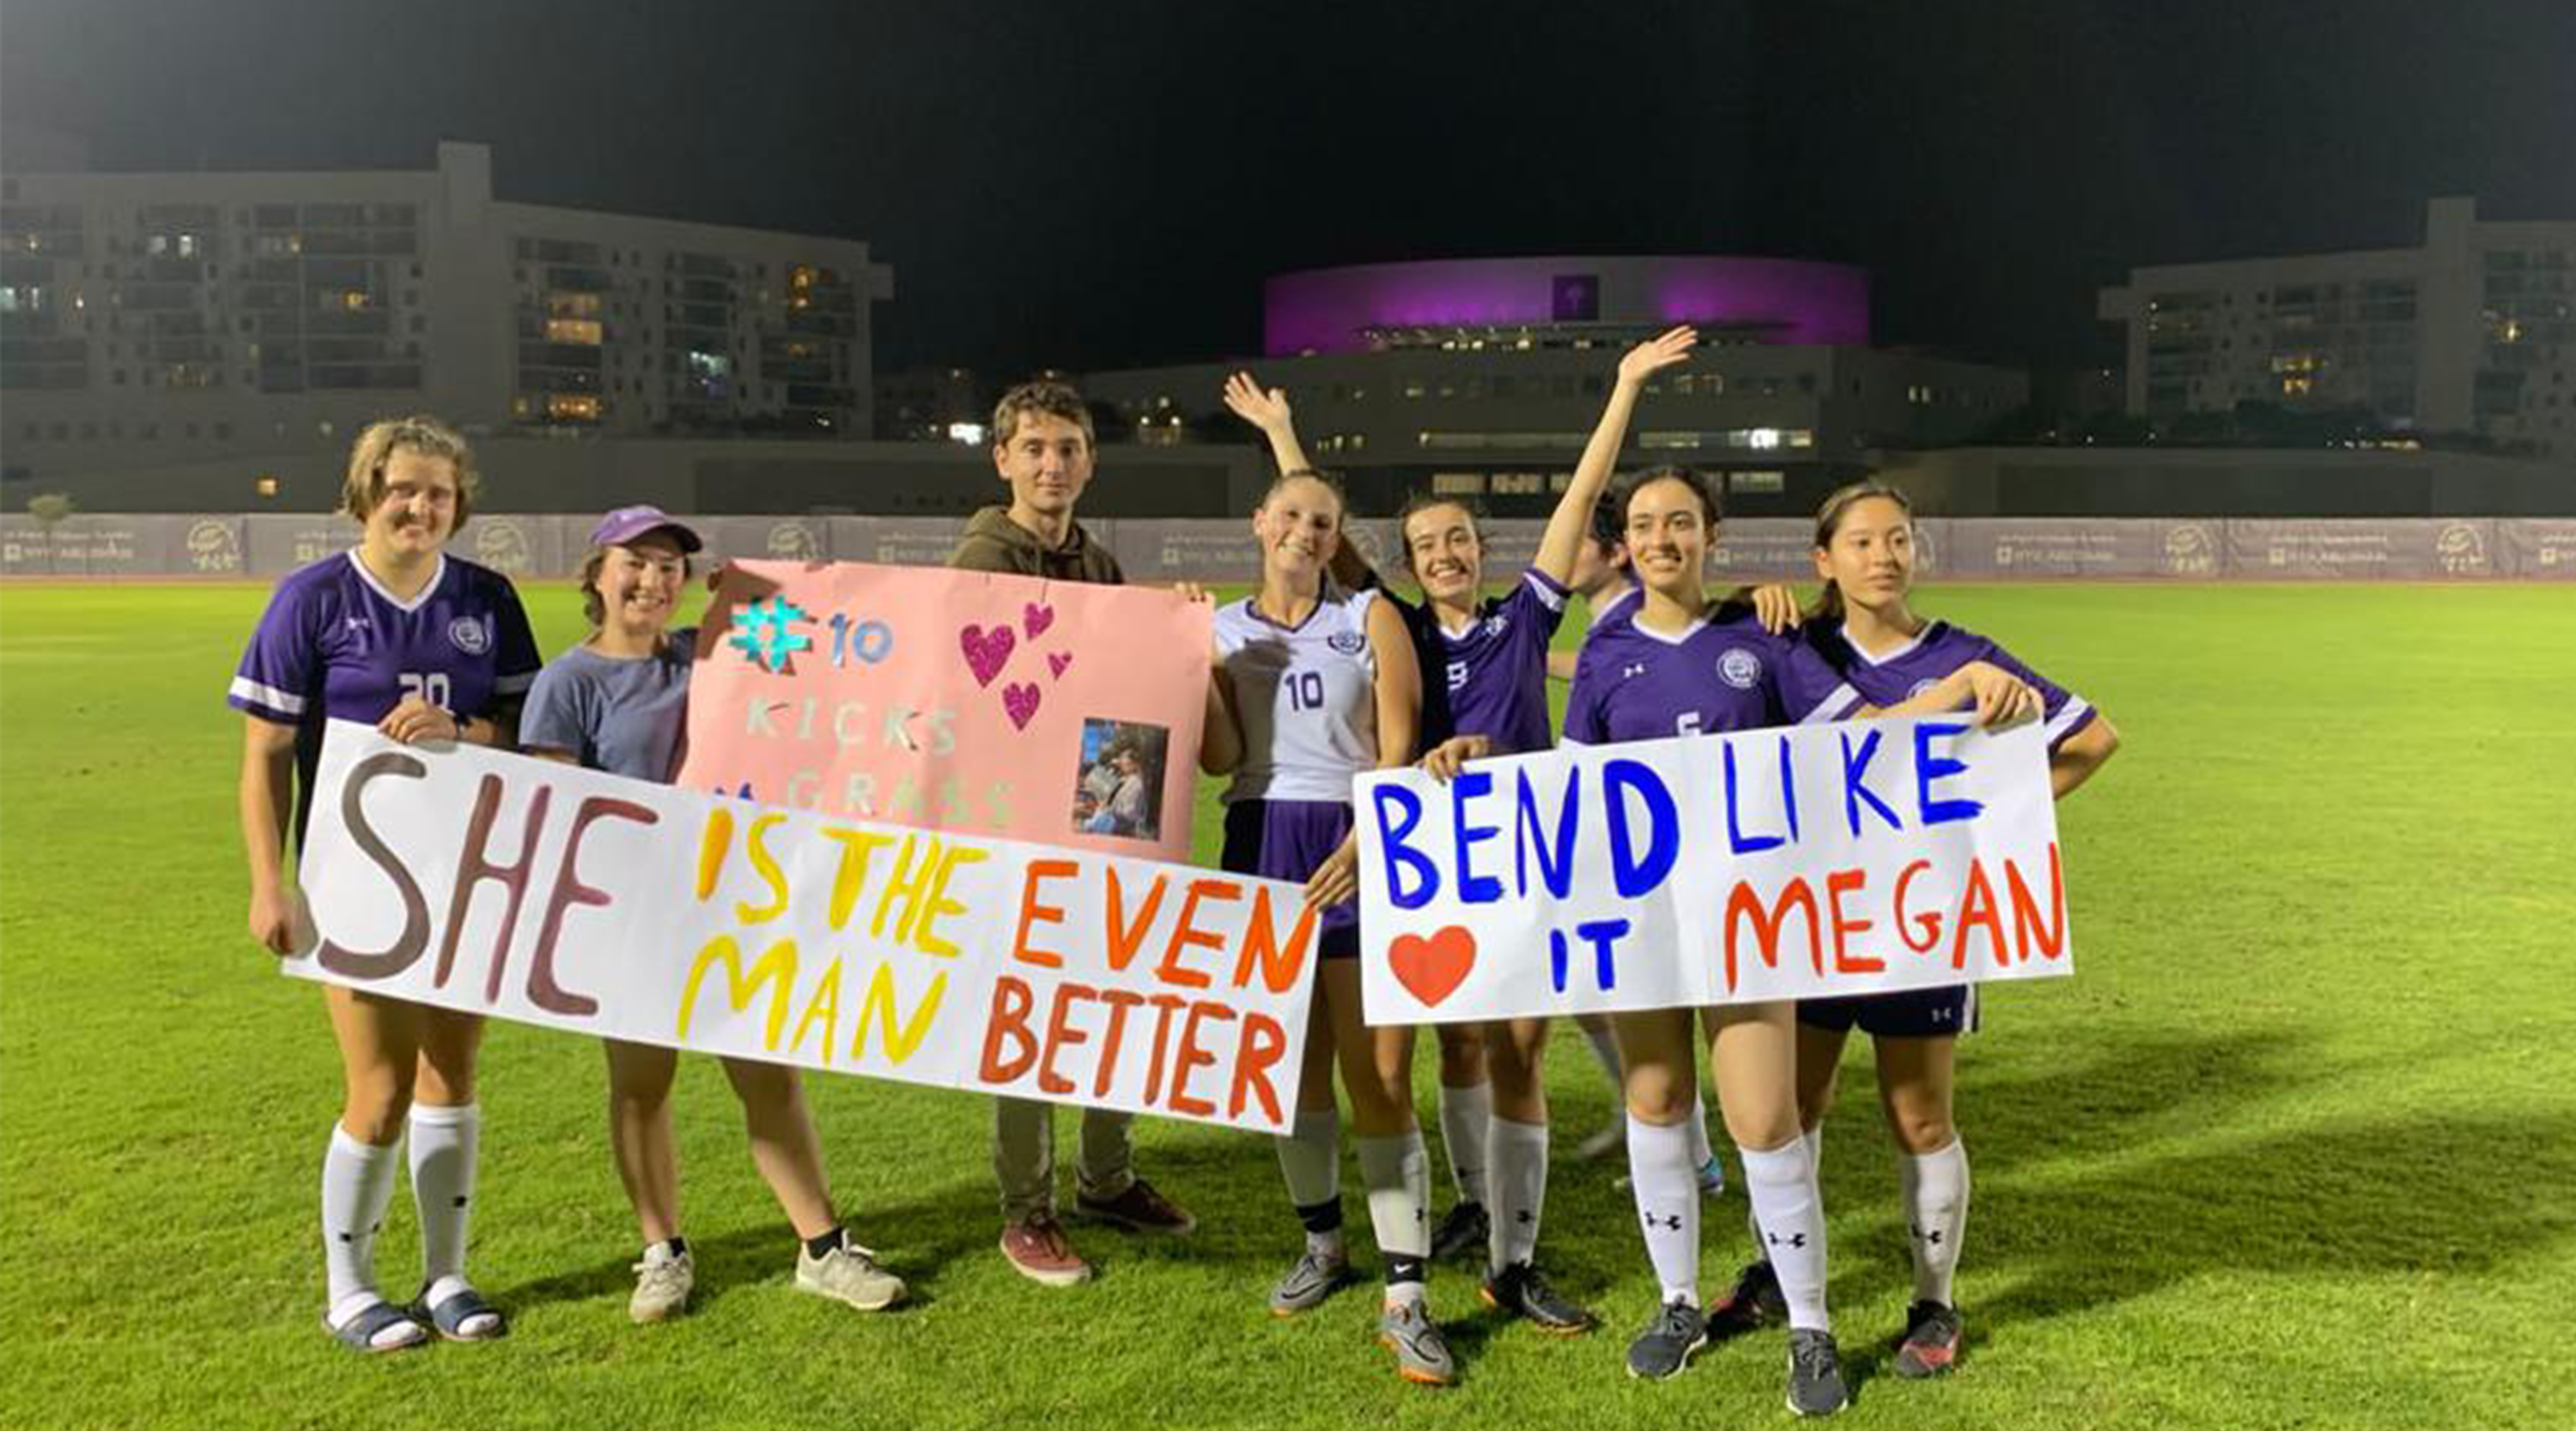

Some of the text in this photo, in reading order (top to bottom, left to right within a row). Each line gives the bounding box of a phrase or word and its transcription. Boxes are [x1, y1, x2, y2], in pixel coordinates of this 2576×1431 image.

[746, 696, 955, 756] KICKS
[1285, 671, 1324, 712] 10
[787, 769, 1015, 827] GRASS
[1373, 723, 1984, 910] BEND LIKE
[316, 752, 659, 1016] SHE
[695, 806, 1318, 994] IS THE EVEN
[1549, 841, 2065, 994] IT MEGAN
[677, 935, 1287, 1125] MAN BETTER
